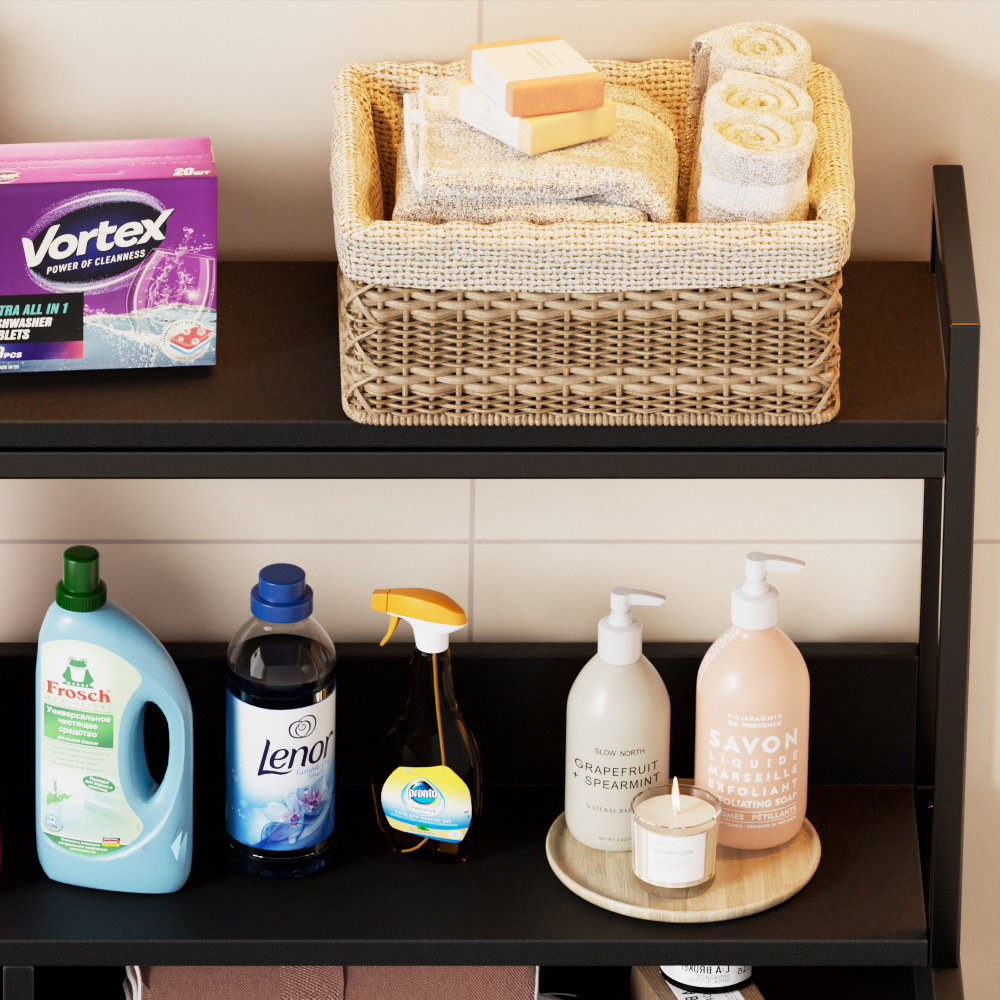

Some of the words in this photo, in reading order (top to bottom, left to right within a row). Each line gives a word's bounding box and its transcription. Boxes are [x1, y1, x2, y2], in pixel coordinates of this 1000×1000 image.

[22, 208, 175, 268] Vortex
[46, 262, 78, 275] POWER
[80, 258, 92, 268] OF
[94, 250, 146, 266] CLEANNESS
[22, 303, 44, 316] ALL
[46, 303, 61, 315] IN
[62, 302, 69, 314] 1
[46, 680, 111, 703] Frosch
[46, 705, 111, 723] Универсальное
[728, 713, 782, 722] COMPAGNIE
[58, 718, 98, 730] чистящее
[59, 726, 98, 738] средство
[742, 720, 782, 729] PROVENCE
[709, 728, 798, 754] SAVON
[257, 729, 333, 776] Lenor
[594, 747, 617, 757] SLOW
[620, 748, 646, 757] NORTH
[708, 749, 798, 769] LIQUIDE
[574, 758, 659, 777] GRAPEFRUIT
[708, 764, 797, 783] MARSEILLE
[585, 771, 660, 790] SPEARMINT
[708, 778, 797, 797] EXFOLIANT
[408, 788, 438, 800] pronto
[775, 792, 797, 806] SOAP
